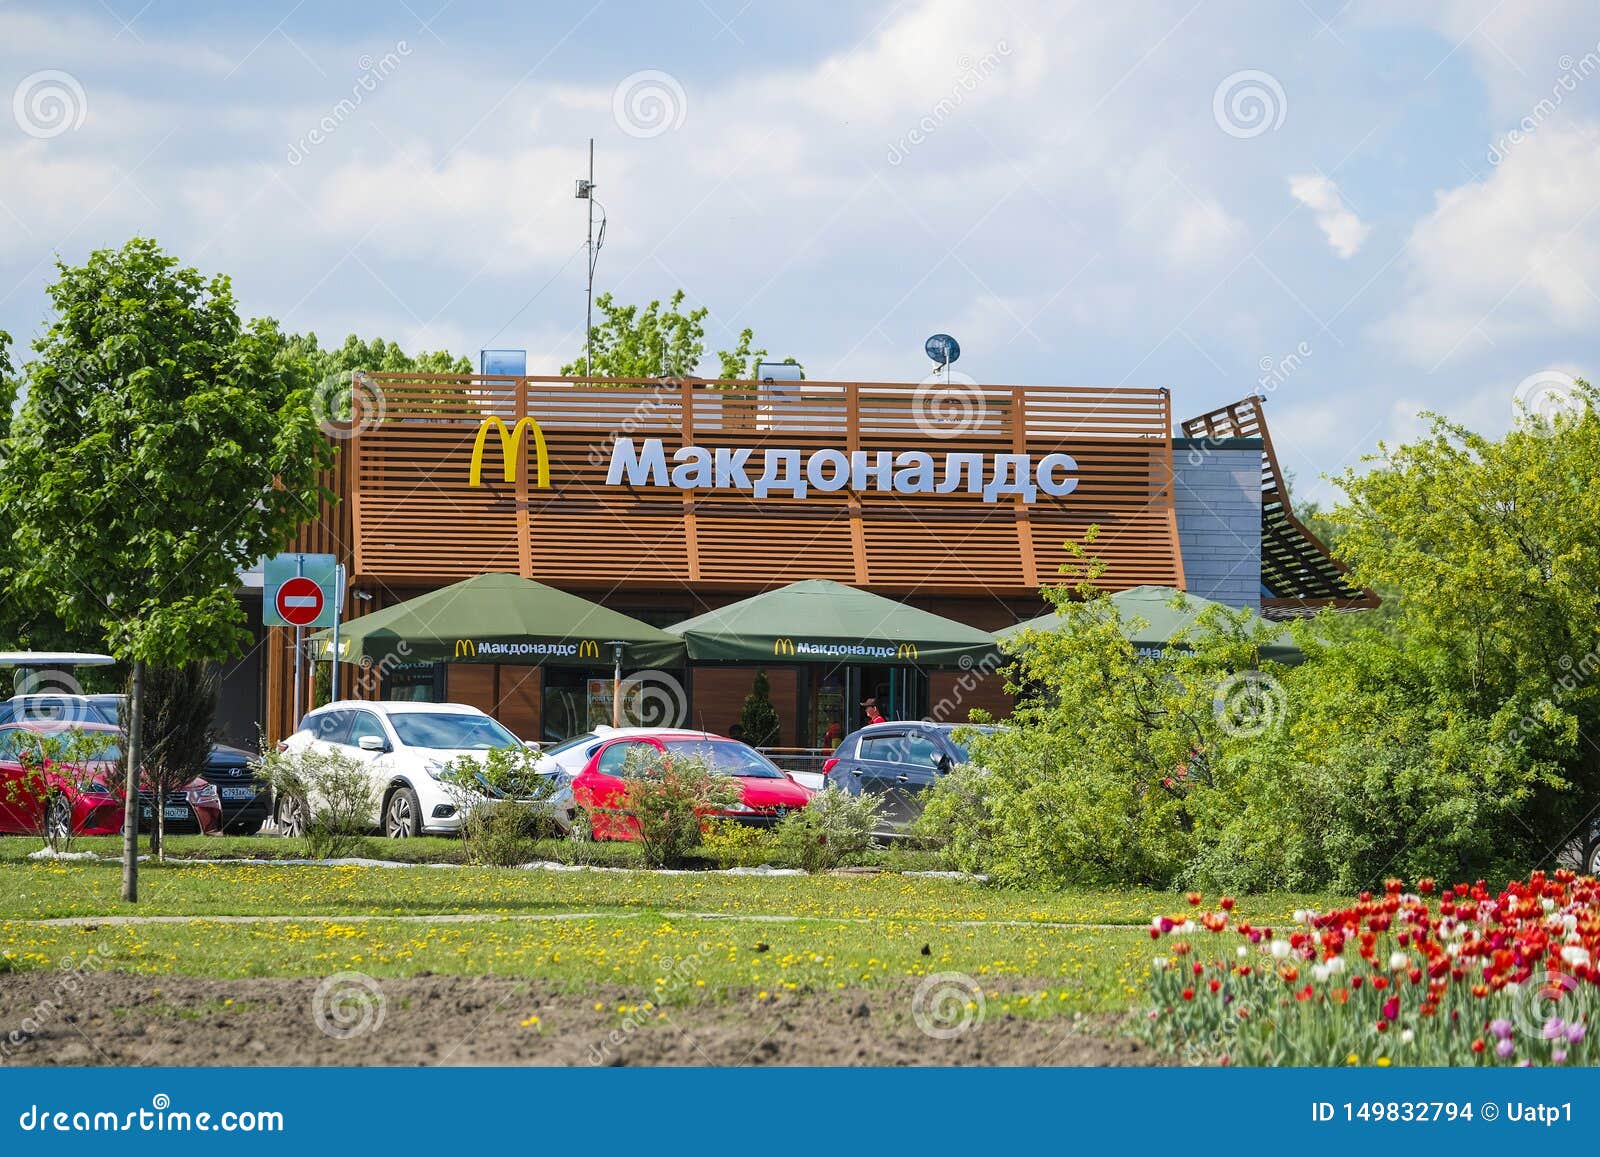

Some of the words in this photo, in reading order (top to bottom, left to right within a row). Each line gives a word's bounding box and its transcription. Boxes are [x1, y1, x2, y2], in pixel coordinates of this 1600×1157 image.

[605, 437, 1080, 503] Макдоналдс
[478, 642, 577, 656] Макдоналдс
[797, 642, 896, 658] Макдоналдс
